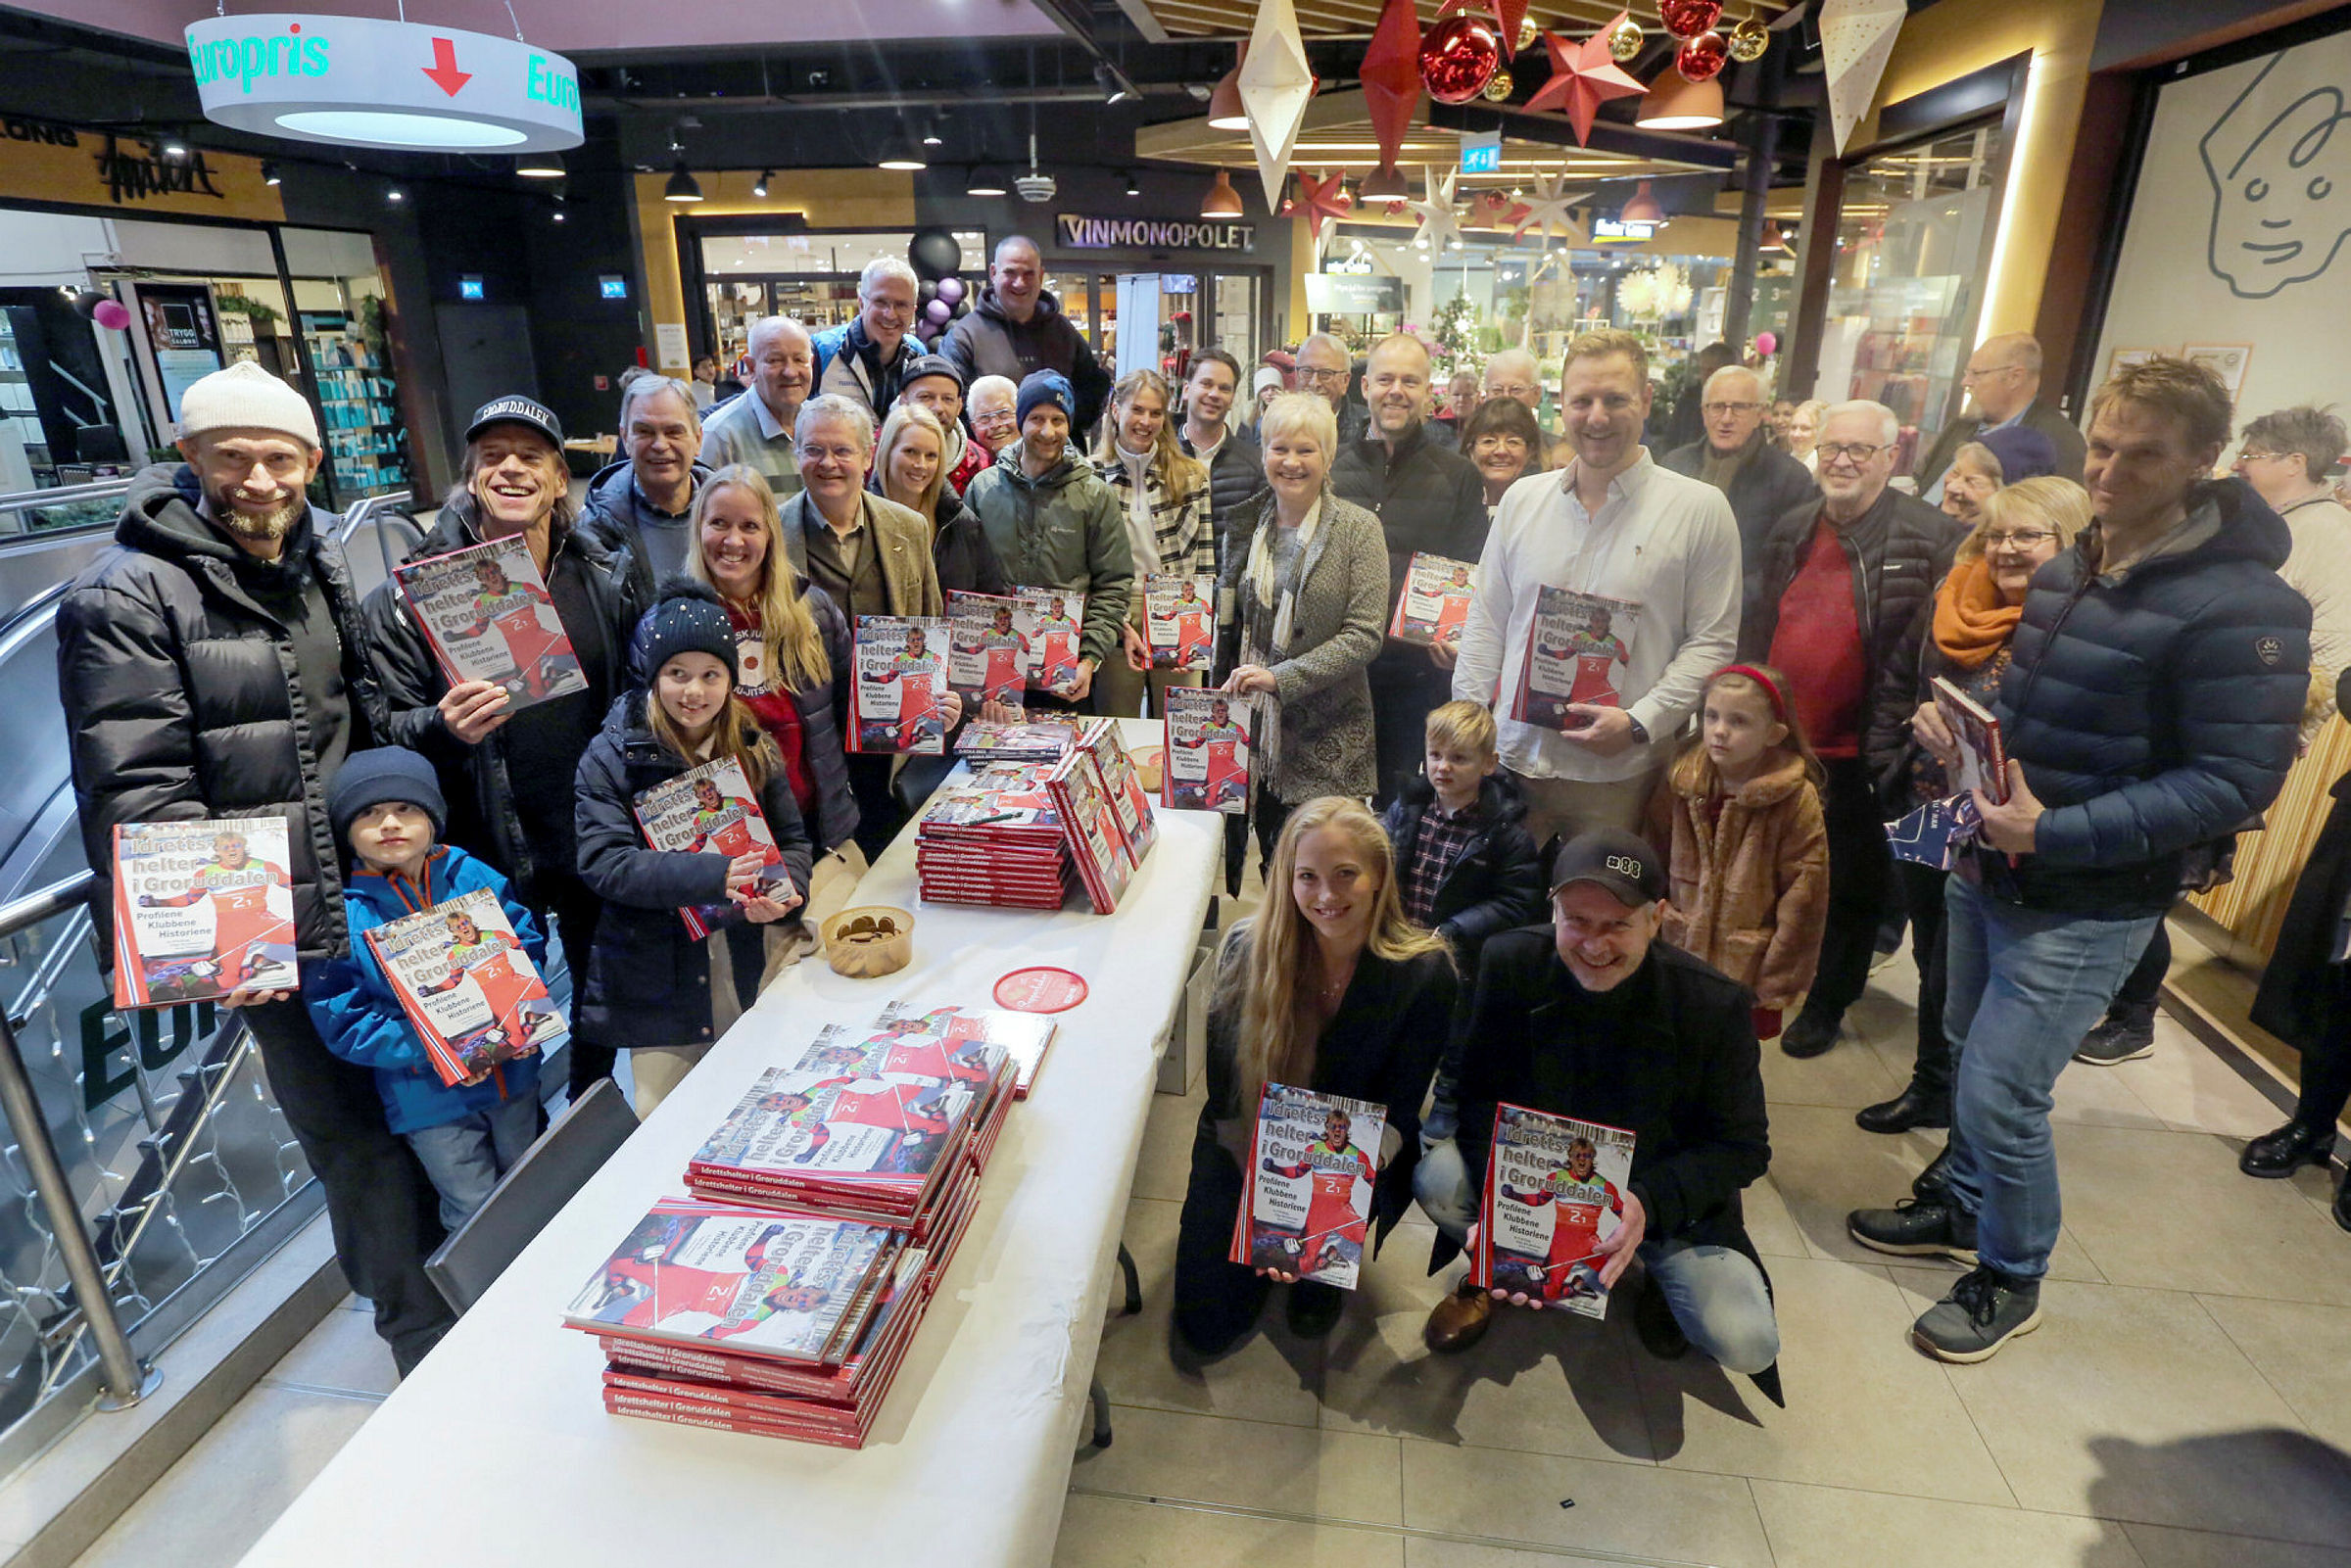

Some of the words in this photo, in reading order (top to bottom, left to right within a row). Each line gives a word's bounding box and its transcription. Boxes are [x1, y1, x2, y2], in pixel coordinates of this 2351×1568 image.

[528, 54, 581, 119] Euro
[1057, 214, 1254, 249] VINMONOPOLET
[423, 592, 473, 614] helter
[431, 618, 439, 631] i
[442, 593, 539, 628] Groruddalen
[1541, 616, 1578, 633] helter
[459, 646, 495, 660] Klubbene
[471, 651, 509, 666] Historiene
[862, 644, 896, 655] helter
[650, 809, 694, 834] helter
[657, 837, 665, 850] i
[665, 806, 749, 846] Groruddalen
[132, 857, 196, 874] helter
[133, 879, 138, 893] i
[144, 872, 278, 891] Groruddalen
[136, 911, 183, 920] Profilene
[148, 920, 197, 928] Klubbene
[159, 927, 213, 938] Historiene
[396, 942, 447, 970] helter
[405, 973, 415, 987] i
[413, 938, 511, 982] Groruddalen
[423, 992, 456, 1010] Profilene
[436, 997, 470, 1015] Klubbene
[448, 1001, 485, 1019] Historiene
[1270, 1102, 1327, 1125] Idretts-
[1266, 1120, 1312, 1142] helter
[1261, 1140, 1268, 1155] i
[1270, 1142, 1366, 1175] Groruddalen
[1504, 1146, 1555, 1170] helter
[701, 1166, 749, 1181] Idrettshelter
[755, 1171, 805, 1188] Groruddalen
[1259, 1174, 1290, 1188] Profilene
[1500, 1165, 1506, 1181] i
[1509, 1168, 1613, 1207] Groruddalen
[694, 1178, 744, 1192] Idrettshelter
[748, 1185, 798, 1201] Groruddalen
[1264, 1187, 1297, 1200] Klubbene
[1270, 1198, 1306, 1212] Historiene
[1497, 1201, 1531, 1215] Profilene
[1504, 1212, 1539, 1227] Klubbene
[1510, 1225, 1549, 1241] Historiene
[792, 1226, 836, 1274] helter
[614, 1378, 667, 1394] Idrettshelter
[674, 1388, 729, 1403] Groruddalen
[614, 1395, 668, 1408] Idrettshelter
[675, 1402, 731, 1417] Groruddalen
[618, 1406, 671, 1421] Idrettshelter
[677, 1414, 733, 1430] Groruddalen
